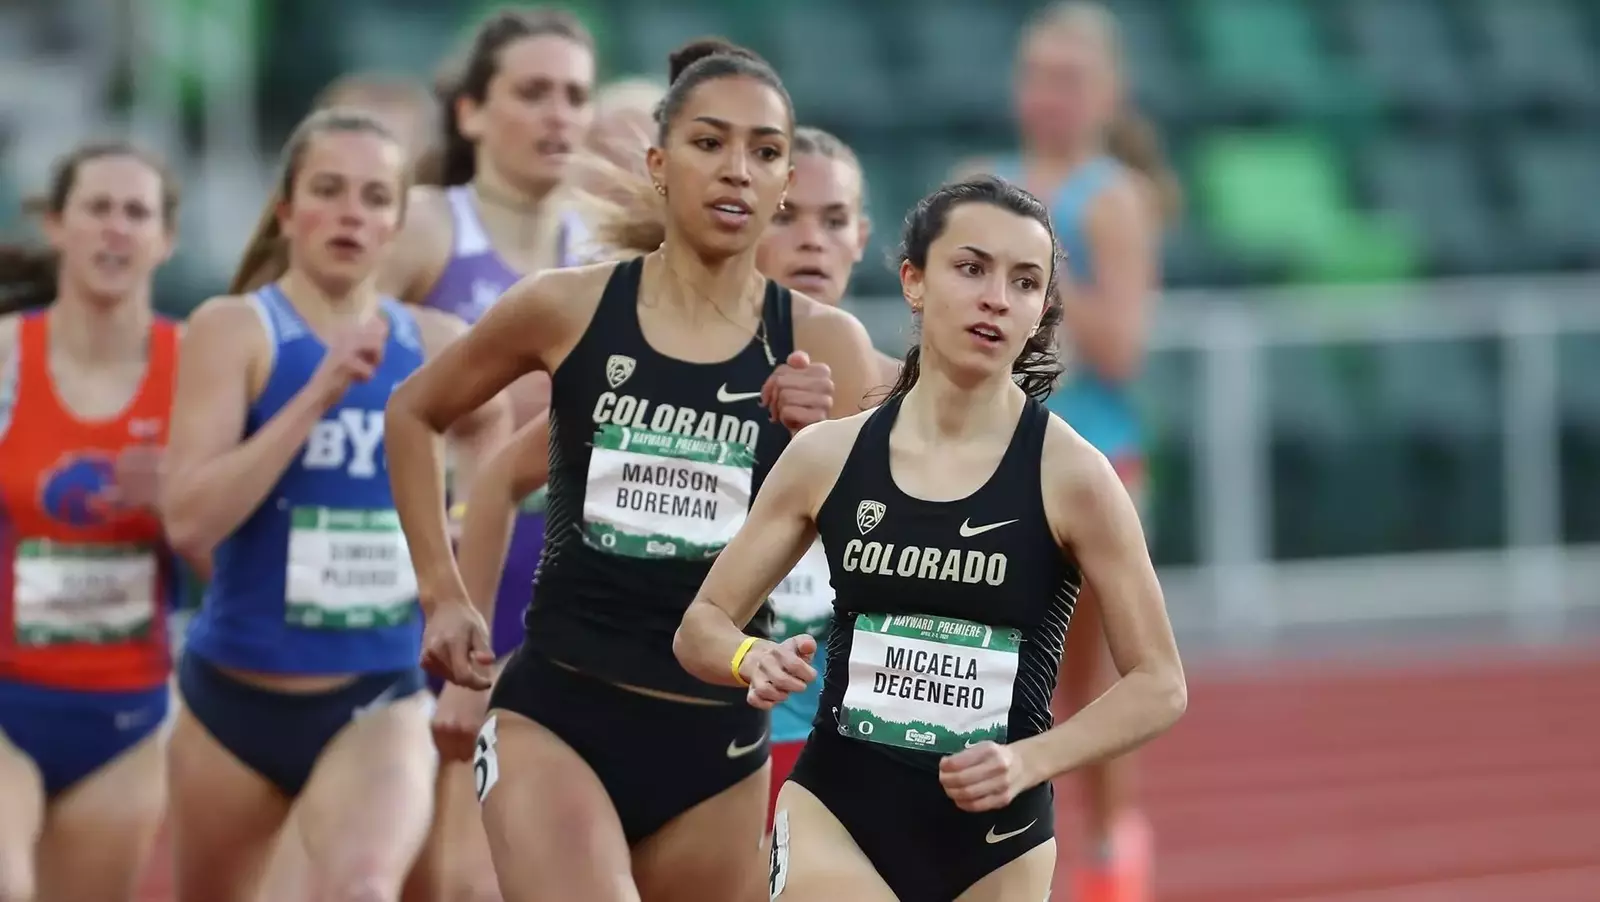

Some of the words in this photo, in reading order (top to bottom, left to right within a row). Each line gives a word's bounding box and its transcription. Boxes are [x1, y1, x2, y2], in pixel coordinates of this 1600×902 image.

[592, 391, 760, 451] COLORADO
[303, 408, 387, 478] BY
[622, 463, 719, 494] MADISON
[616, 487, 718, 521] BOREMAN
[842, 538, 1008, 587] COLORADO
[893, 615, 934, 631] HAYWARD
[936, 621, 982, 638] PREMIERE
[885, 646, 977, 681] MICAELA
[873, 672, 985, 710] DEGENERO
